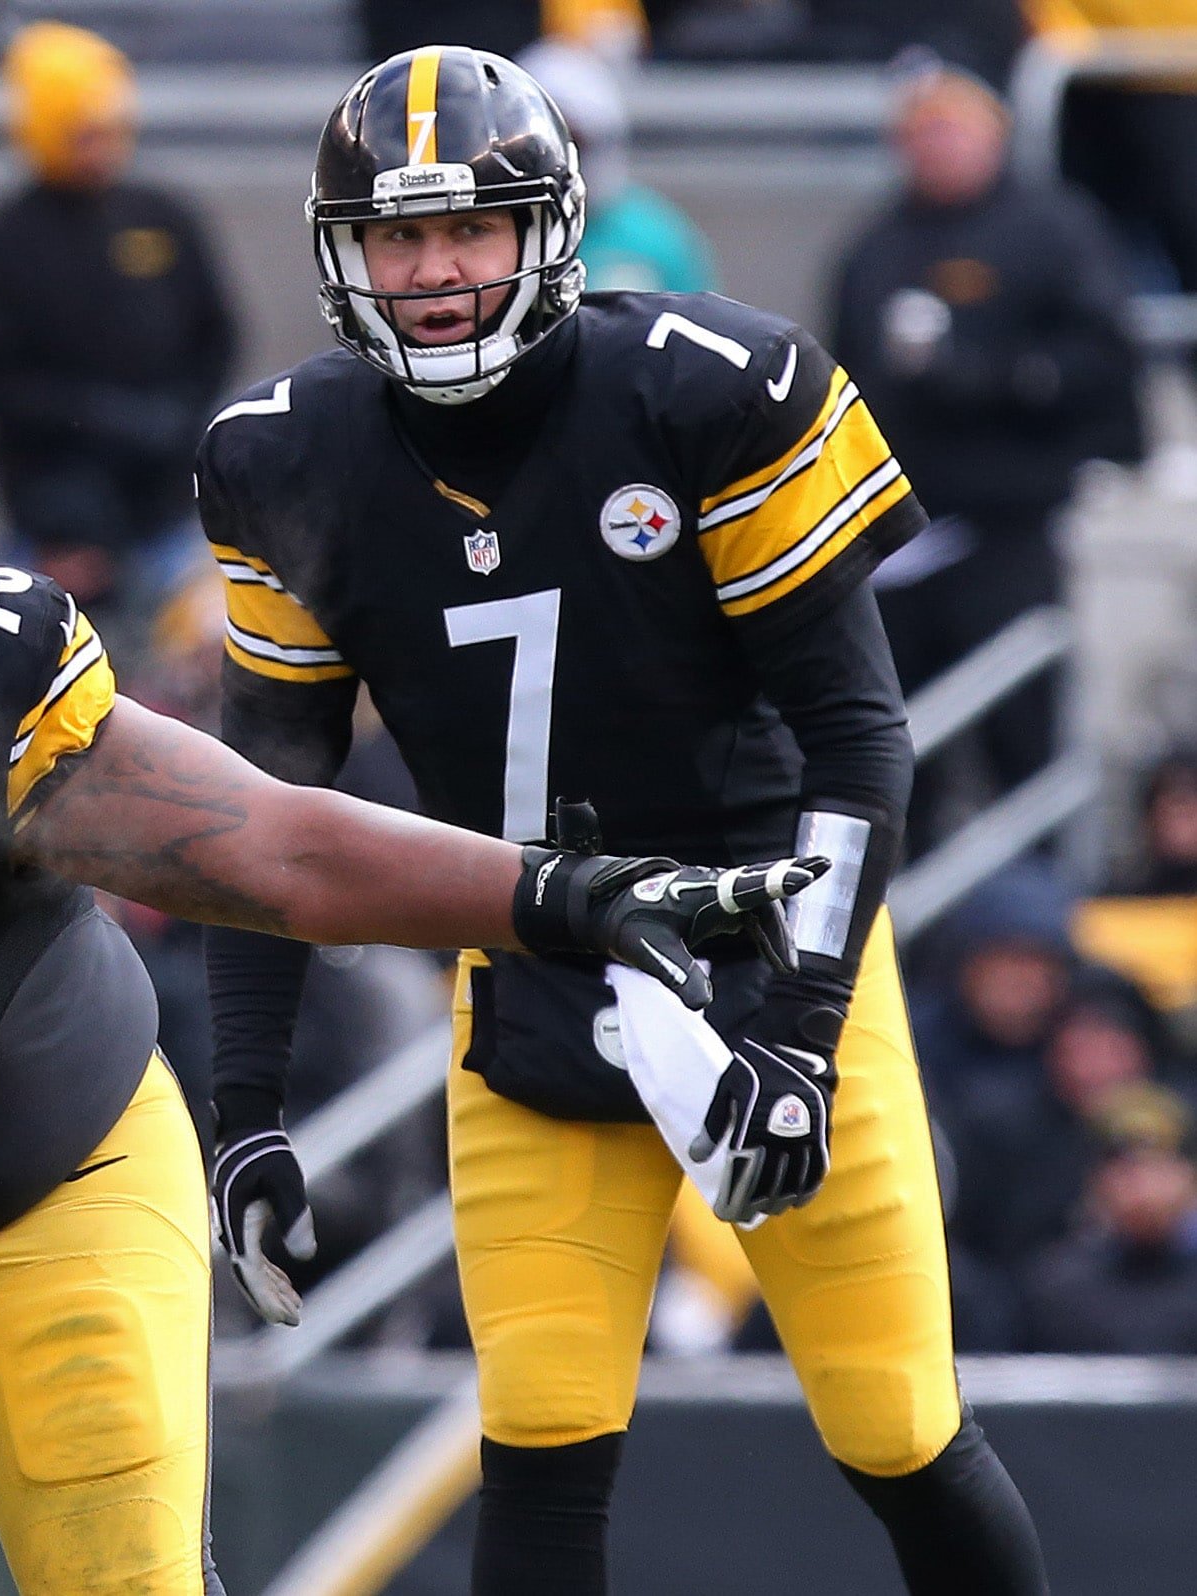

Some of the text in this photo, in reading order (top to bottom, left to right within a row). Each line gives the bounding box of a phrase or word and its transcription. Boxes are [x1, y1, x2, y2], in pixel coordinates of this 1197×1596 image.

[409, 111, 438, 166] 7
[399, 170, 446, 187] Steelers
[646, 311, 752, 370] 7
[207, 377, 292, 432] 7
[443, 587, 562, 842] 7
